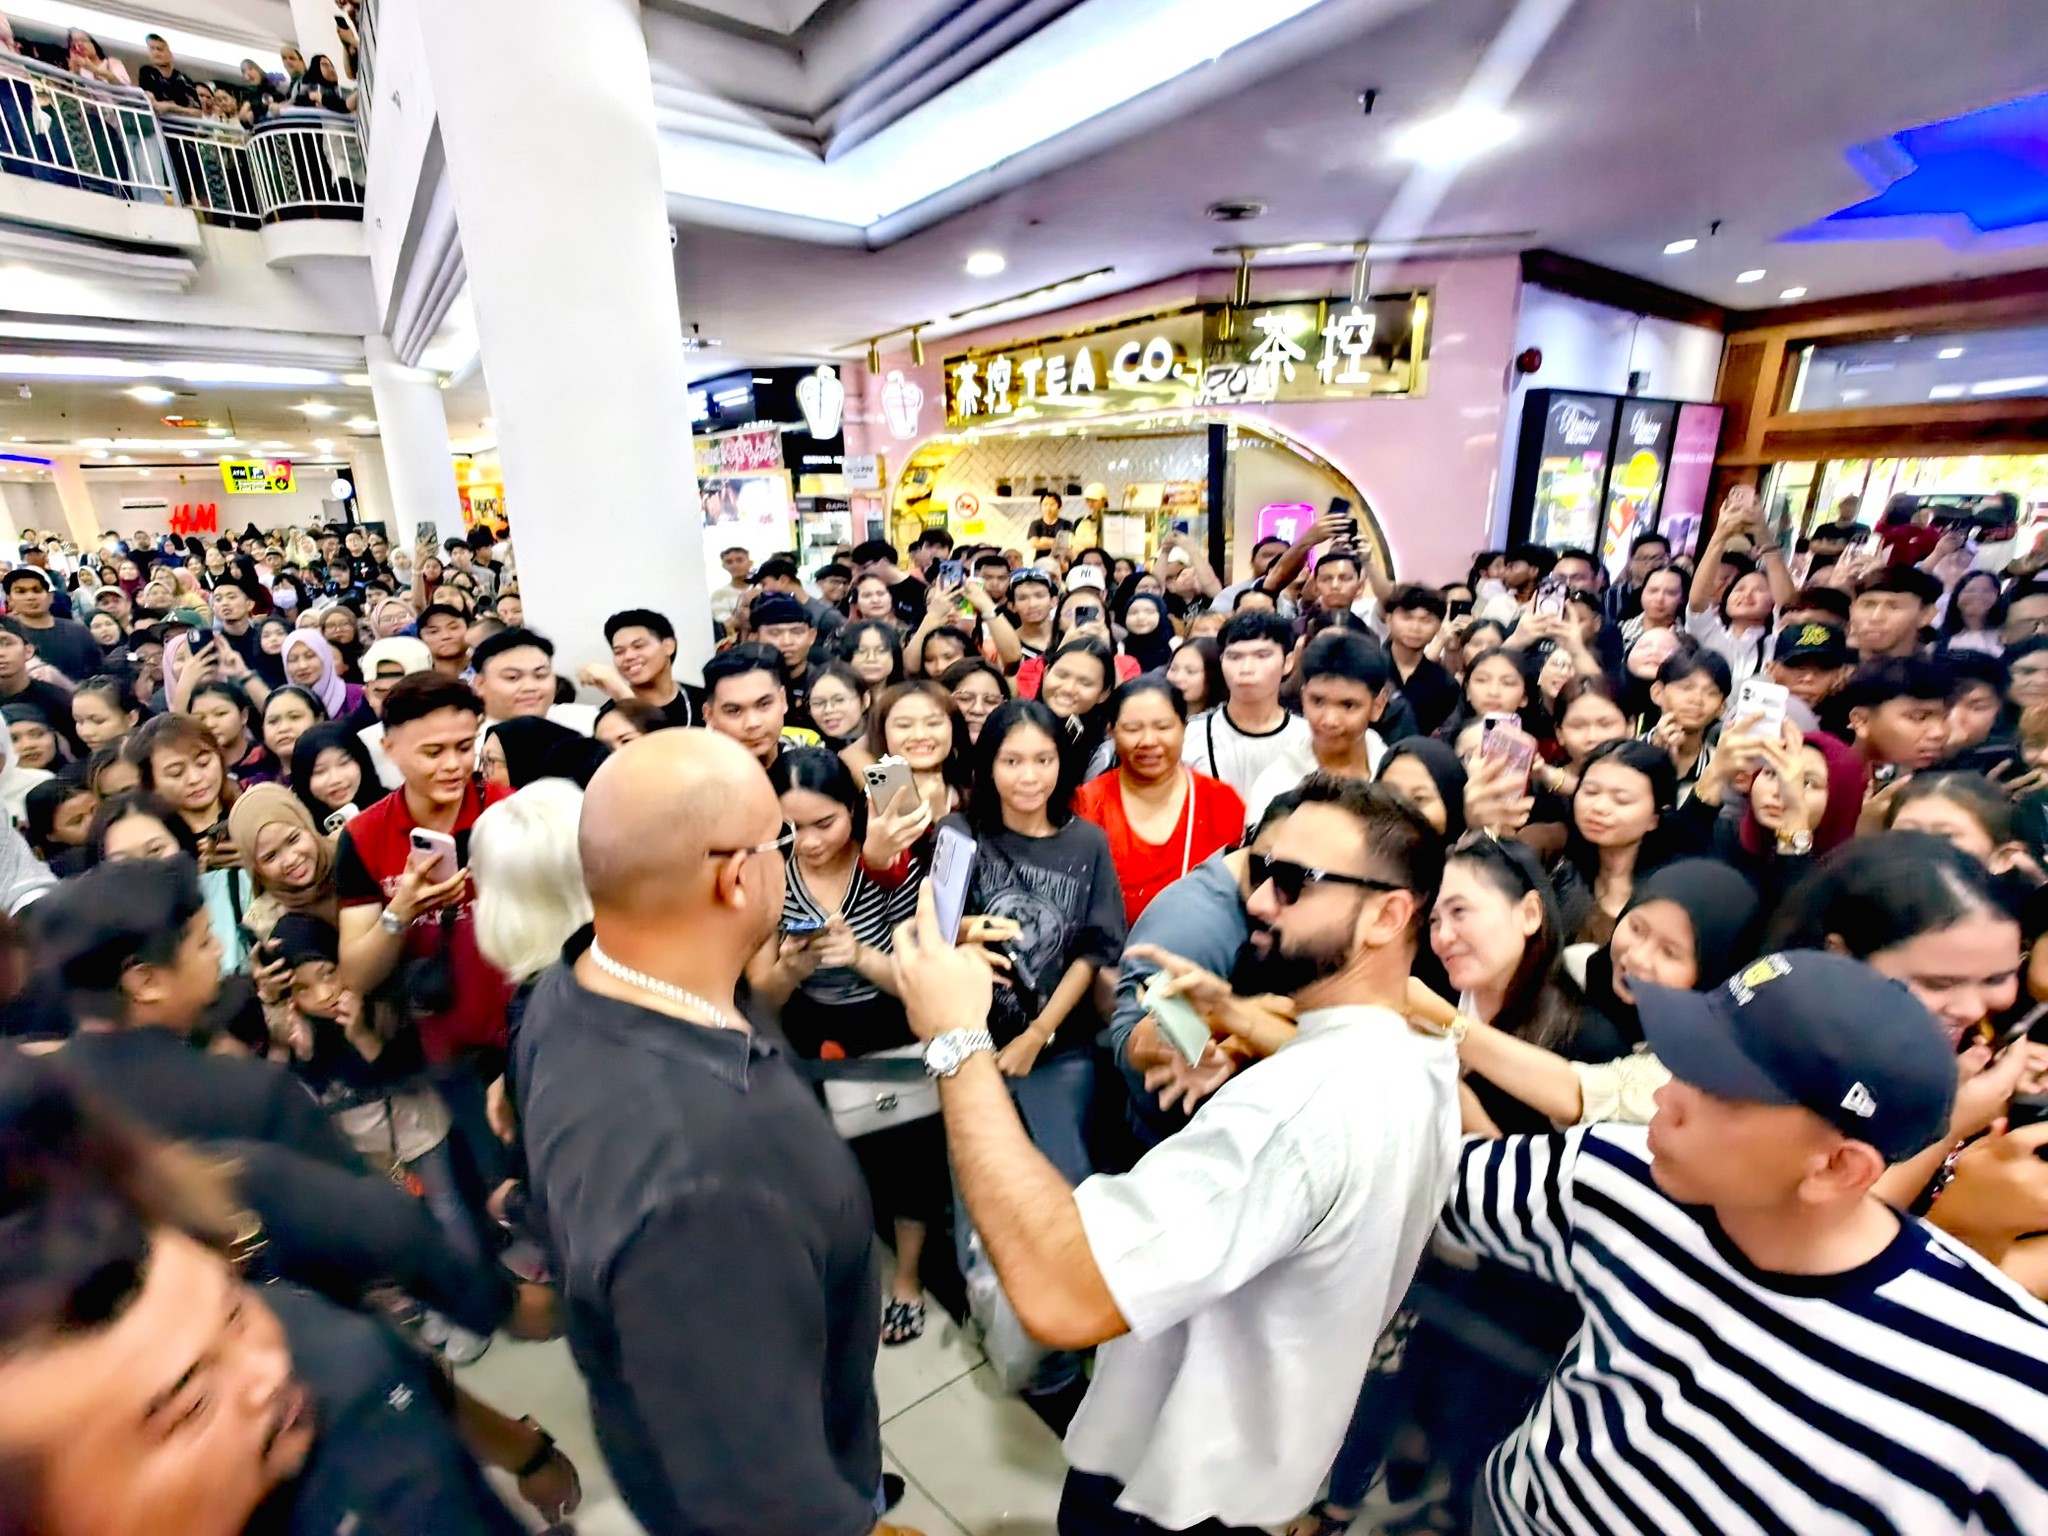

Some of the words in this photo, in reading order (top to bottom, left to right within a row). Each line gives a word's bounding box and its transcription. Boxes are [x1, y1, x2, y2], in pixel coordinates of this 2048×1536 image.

[1020, 346, 1096, 400] TEA
[1112, 337, 1183, 385] CO.
[1249, 305, 1376, 385] 茶控
[169, 503, 217, 535] H&M
